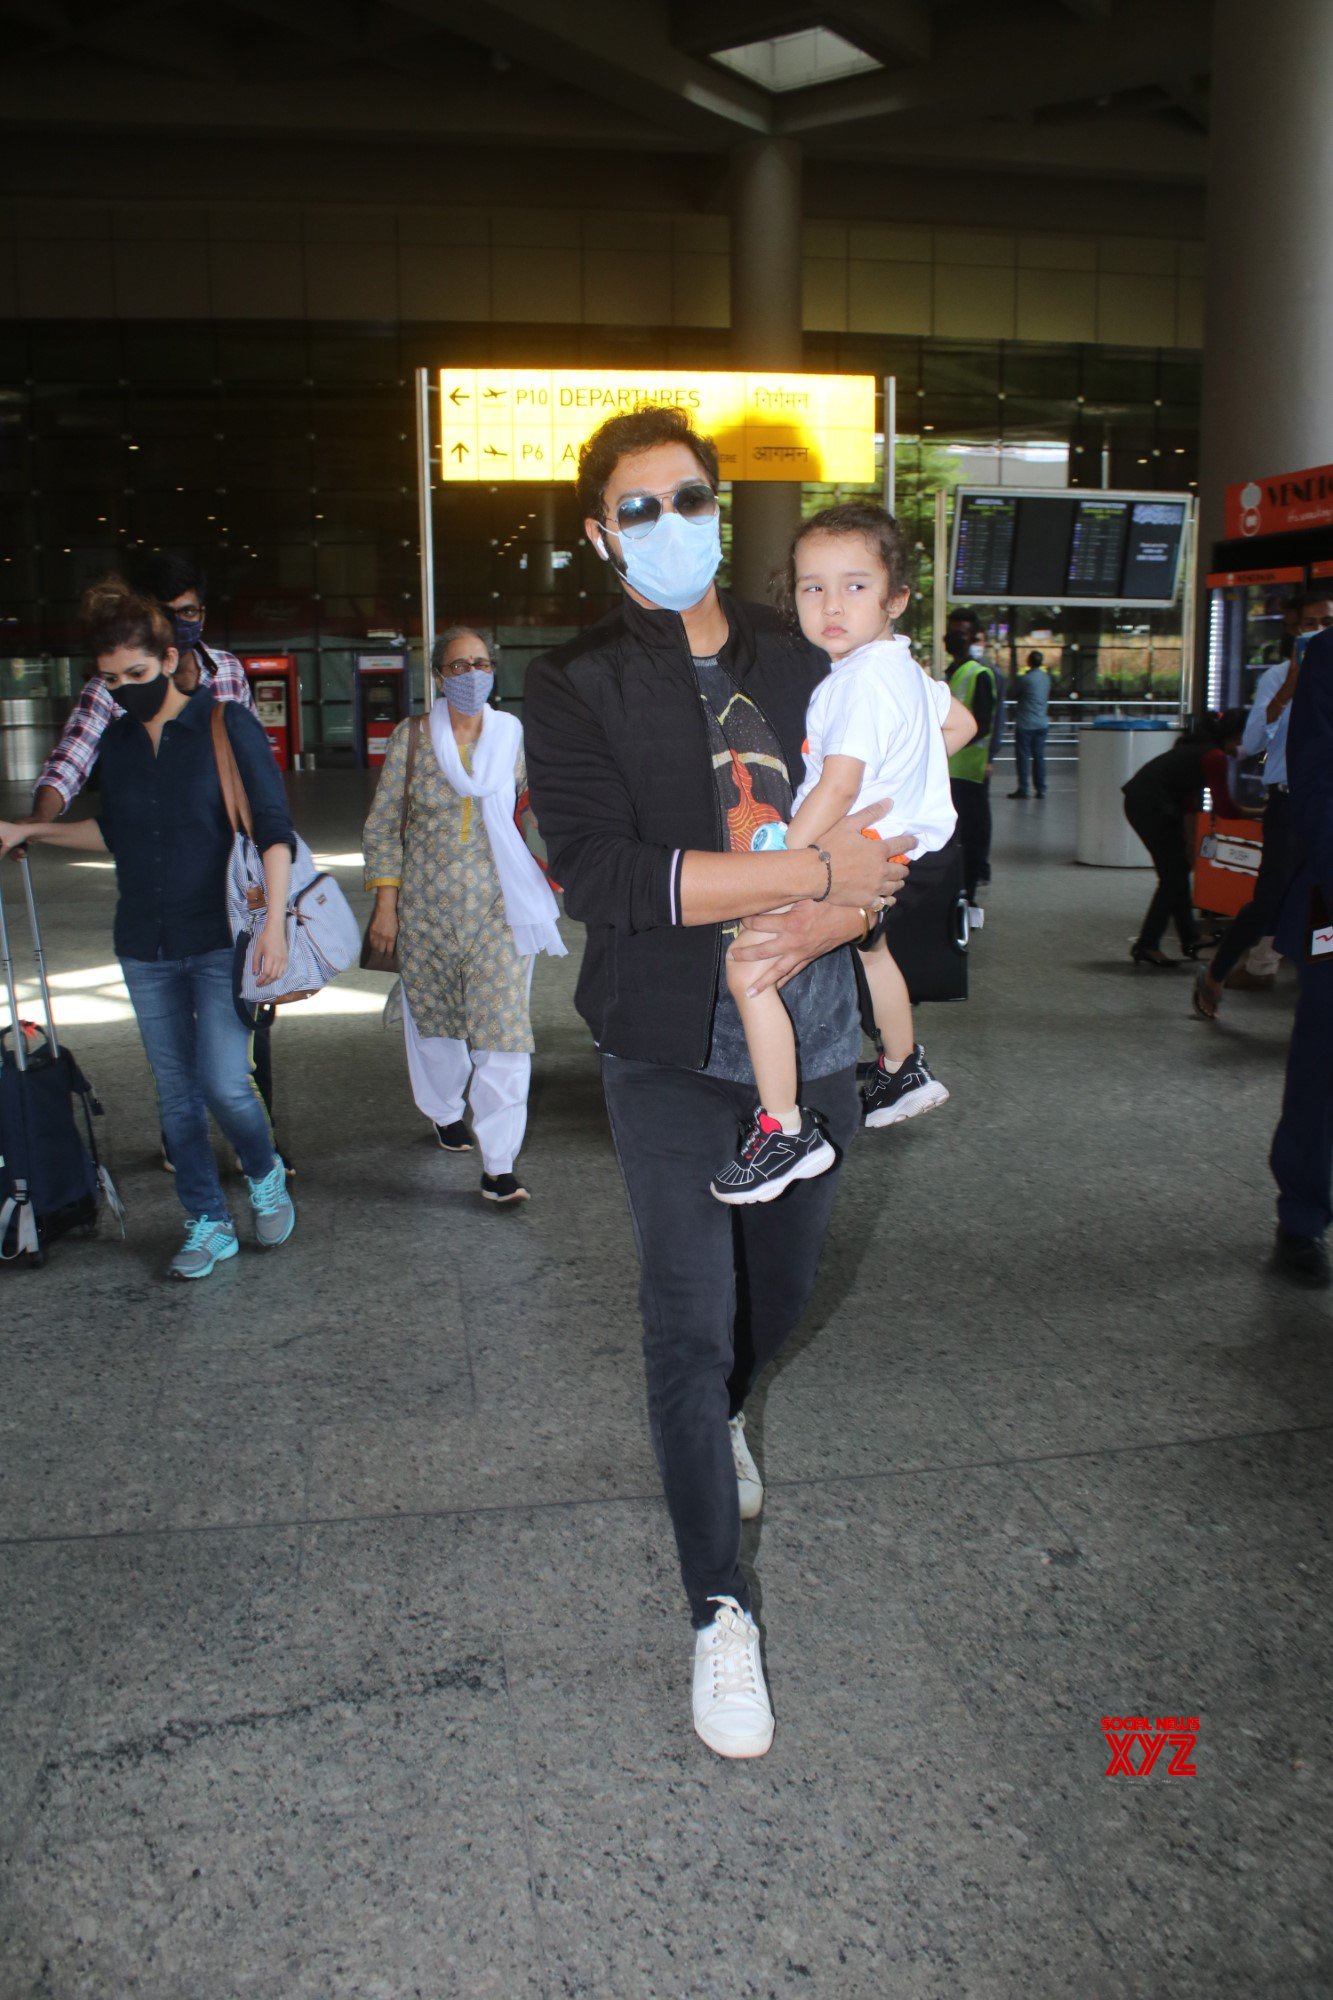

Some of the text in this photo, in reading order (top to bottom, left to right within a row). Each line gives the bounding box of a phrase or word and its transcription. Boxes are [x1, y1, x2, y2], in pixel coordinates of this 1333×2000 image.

[516, 388, 701, 408] P10 DEPARTURES
[522, 444, 544, 460] P6
